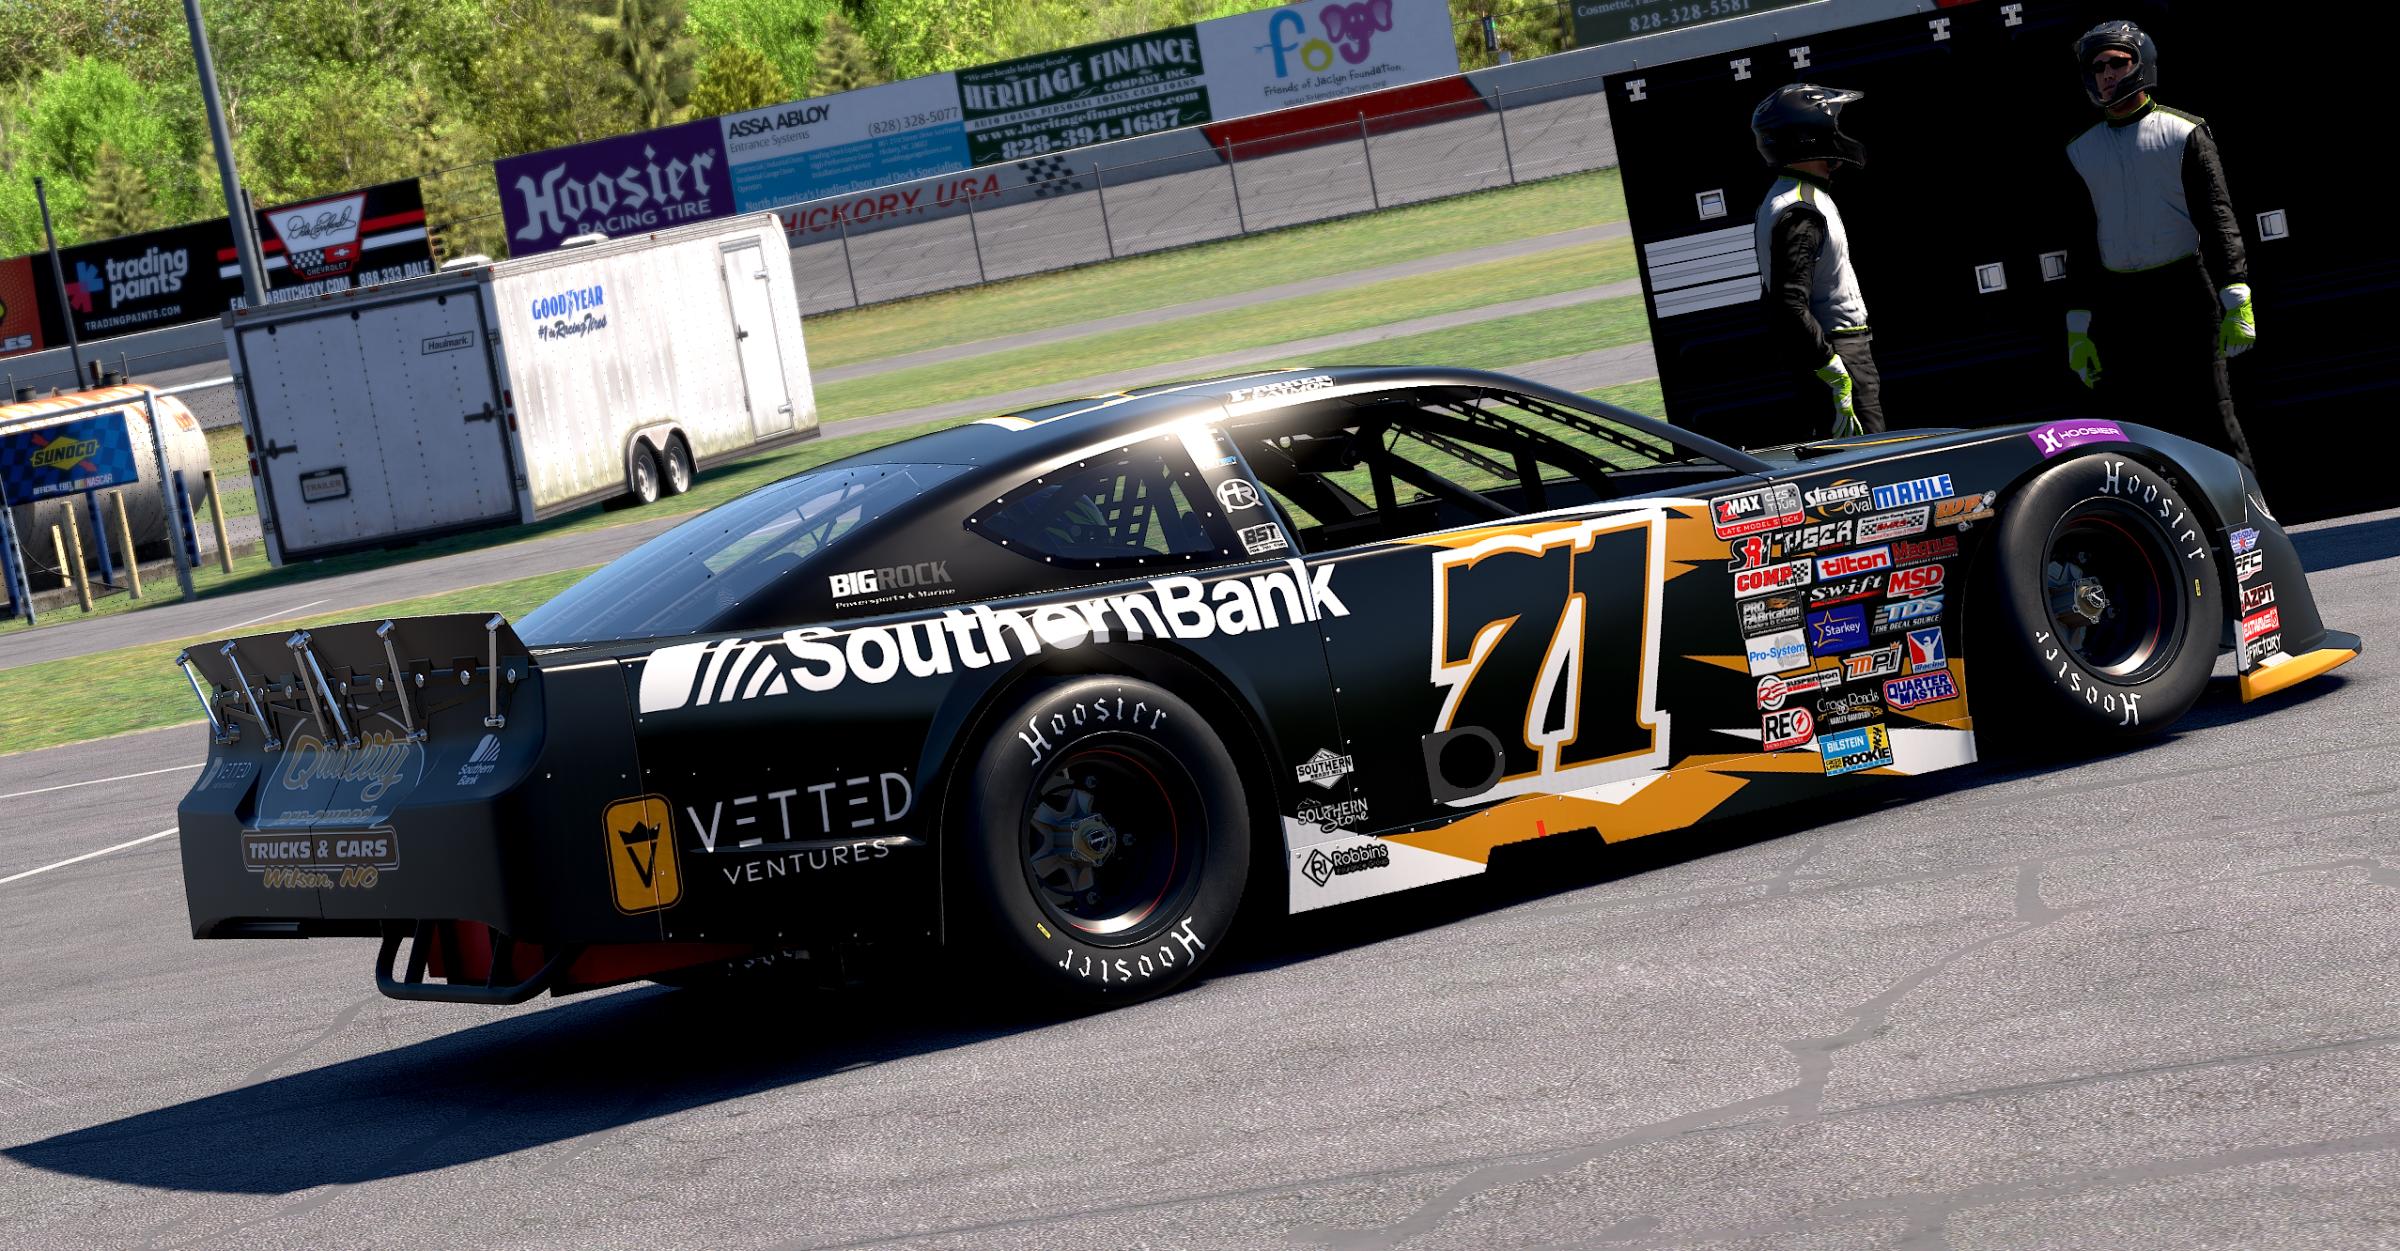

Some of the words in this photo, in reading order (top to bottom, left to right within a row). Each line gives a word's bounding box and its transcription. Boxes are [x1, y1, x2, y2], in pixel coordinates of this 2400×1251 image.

[1629, 0, 1751, 32] 828-328-5581
[963, 63, 1086, 111] HERITAGE
[1089, 38, 1199, 82] FINANCE
[1263, 84, 1299, 97] Friends
[1301, 78, 1312, 89] of
[1314, 73, 1347, 89] Jaclyn
[728, 116, 773, 139] ASSA
[776, 104, 831, 130] ABLOY
[868, 118, 901, 137] (828)
[903, 107, 958, 129] 328-5077
[974, 116, 1001, 129] AUTO
[1002, 108, 1182, 159] 828-394-1687
[729, 136, 771, 153] Entrance
[772, 130, 810, 147] Systems
[515, 144, 714, 240] Hoosier
[936, 173, 999, 208] USA
[578, 210, 658, 236] RACING
[663, 199, 712, 221] TIRE
[105, 246, 188, 281] trading
[306, 261, 348, 276] CHEVROLET
[110, 272, 183, 309] paints
[532, 285, 604, 320] GOODYEAR
[85, 304, 182, 331] TRADINGPAINTS.COM
[0, 335, 33, 351] ES
[2058, 427, 2121, 440] HOOSIER
[34, 441, 98, 466] SUNOCO
[86, 473, 113, 488] NASCAR
[1873, 475, 1953, 509] MAHLE
[1768, 500, 1797, 512] TOUR
[1804, 483, 1869, 508] Strange
[1844, 497, 1873, 515] Oval
[2099, 460, 2206, 560] Hoosier
[1244, 524, 1276, 545] BST
[1722, 527, 1742, 536] LATE
[1743, 521, 1772, 531] MODEL
[1773, 515, 1800, 526] STOCK
[1821, 552, 1888, 577] tilton
[1737, 565, 1794, 592] COMP
[1889, 565, 1944, 595] MSD
[836, 594, 906, 609] Powersports
[918, 588, 956, 598] Marine
[1743, 601, 1765, 615] PRO
[1883, 594, 1945, 623] TDS
[783, 558, 1352, 692] SouthernBank
[1825, 620, 1861, 637] Starkey
[1875, 625, 1888, 633] THE
[1890, 620, 1911, 630] DECAL
[1913, 614, 1940, 625] SOURCE
[1432, 509, 1669, 804] 71
[1749, 641, 1805, 662] Pro-System
[1886, 673, 1949, 698] QUARTER
[2035, 630, 2142, 726] Hoosier
[1848, 688, 1879, 706] Roads
[1900, 684, 1954, 704] MASTER
[1018, 687, 1169, 767] Hoosier
[1827, 736, 1865, 753] BILSTEIN
[458, 762, 496, 777] Southern
[1298, 756, 1353, 776] SOUTHERN
[1842, 748, 1891, 767] ROOKIE
[457, 774, 480, 786] Bank
[686, 772, 913, 853] VETTED
[1297, 798, 1369, 825] SOUTHERN
[1321, 811, 1369, 833] Stone
[249, 841, 311, 860] TRUCKS
[317, 839, 328, 859] &
[336, 838, 388, 858] CARS
[1333, 845, 1387, 866] Robbins
[722, 839, 890, 885] VENTURES
[264, 866, 335, 889] Wilson,
[339, 865, 379, 888] NC
[1058, 916, 1206, 993] Hoosier
